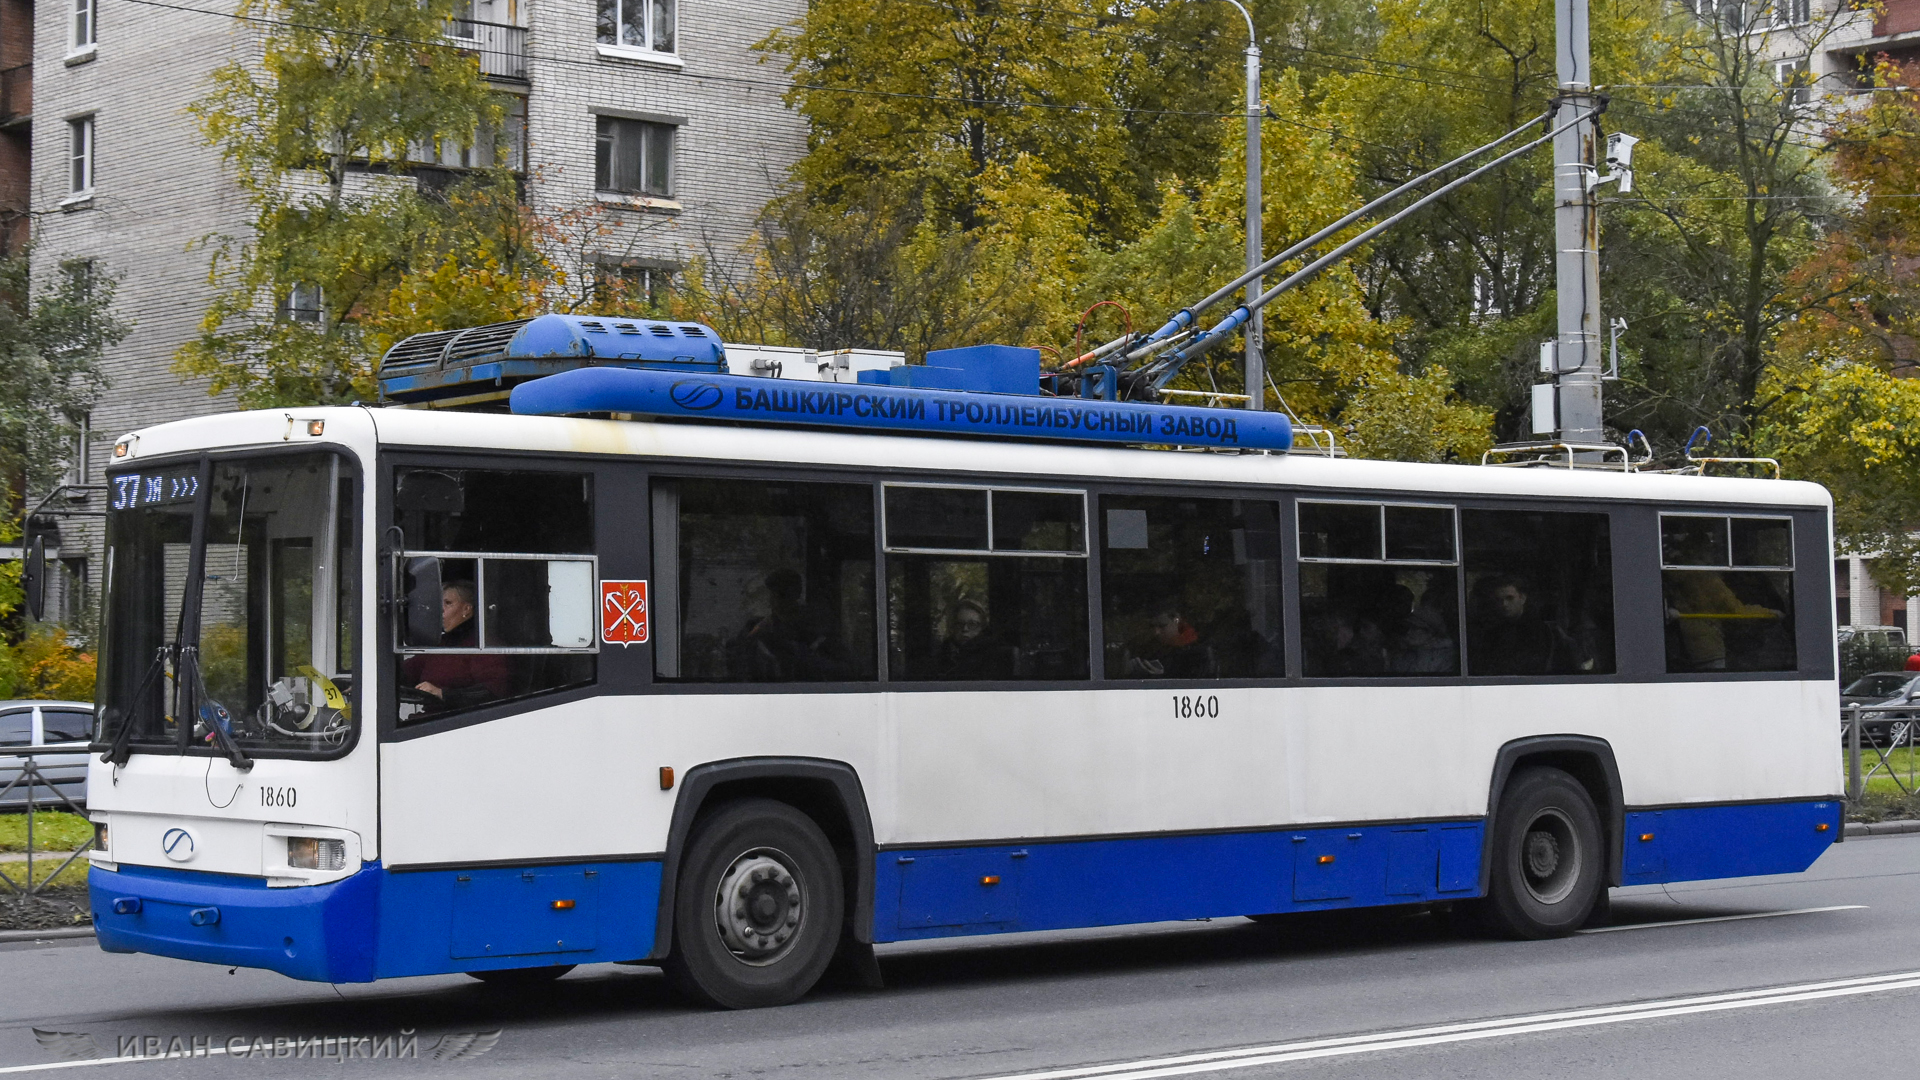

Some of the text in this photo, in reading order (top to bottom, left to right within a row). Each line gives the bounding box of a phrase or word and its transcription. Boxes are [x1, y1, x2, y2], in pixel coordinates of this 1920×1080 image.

[1160, 414, 1239, 443] ЗАВОД
[114, 474, 140, 510] 37
[324, 687, 338, 701] 37
[1172, 695, 1219, 719] 1860
[260, 786, 297, 808] 1860
